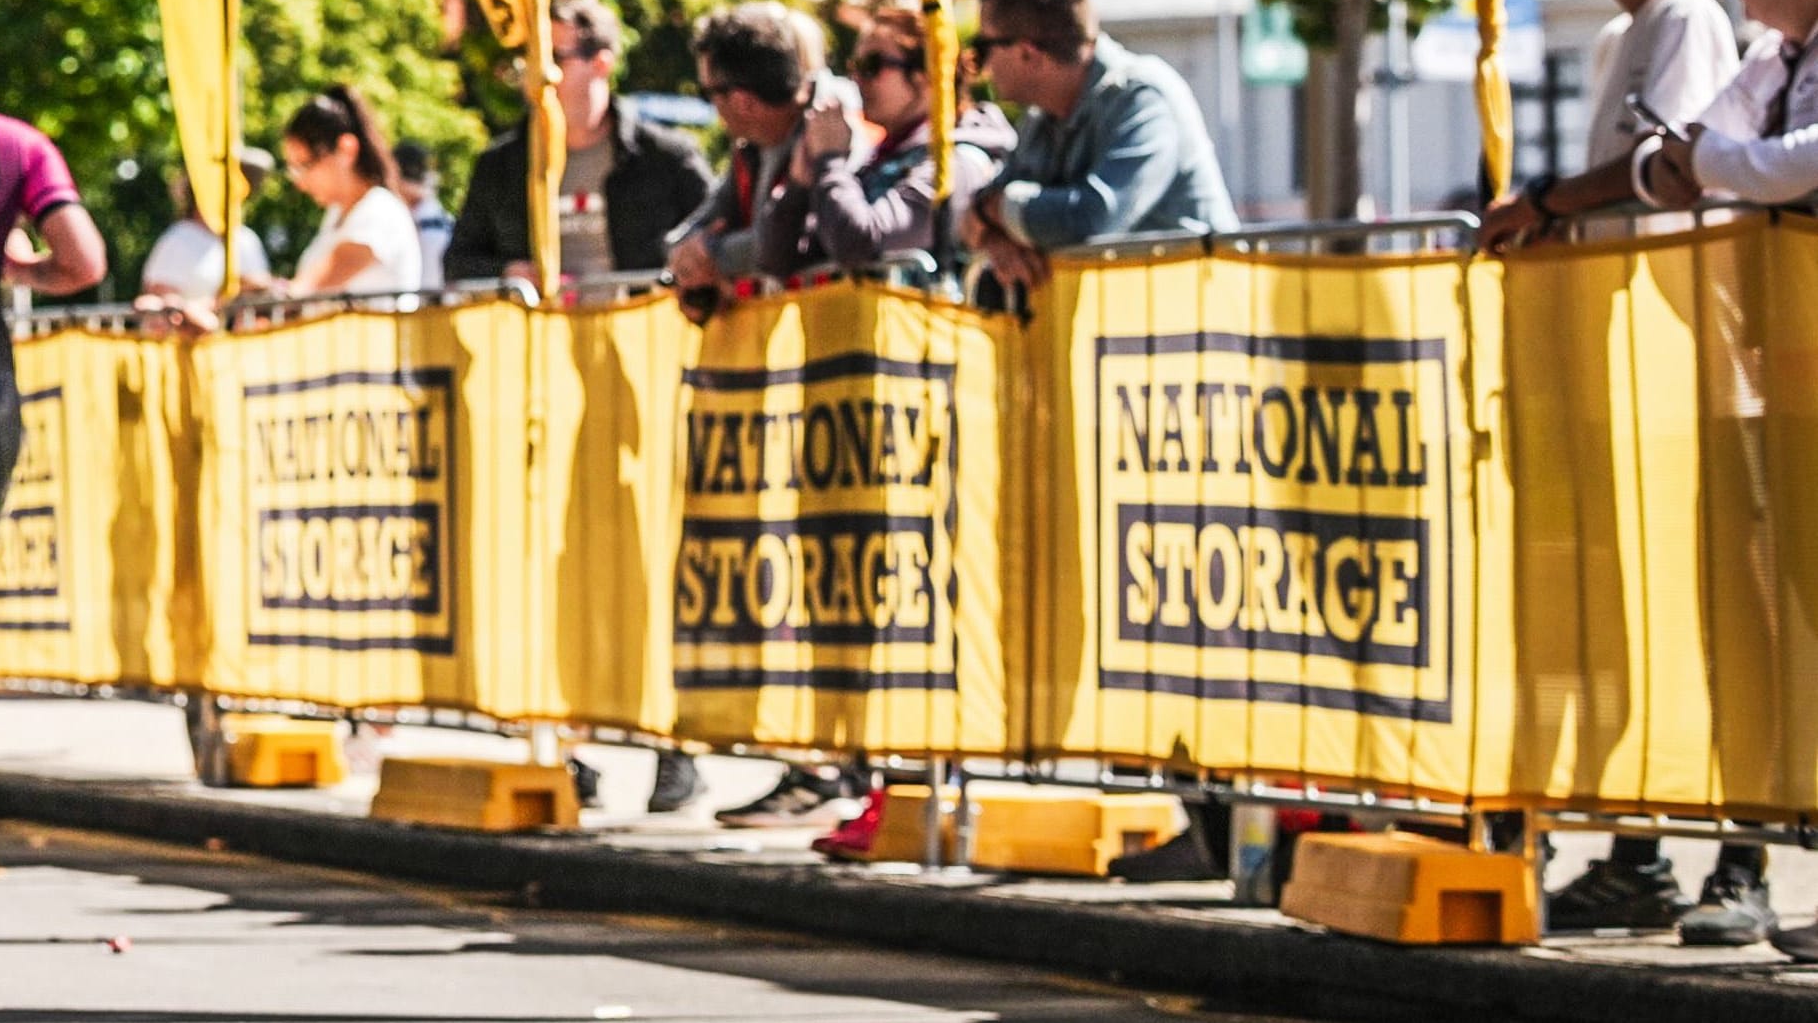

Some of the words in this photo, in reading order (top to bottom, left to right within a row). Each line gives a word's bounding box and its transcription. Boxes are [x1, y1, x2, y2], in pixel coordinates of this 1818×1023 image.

[256, 408, 442, 483] NATIONAL
[685, 398, 936, 495] NATIONAL
[1115, 382, 1428, 487] NATIONAL
[261, 513, 431, 604] STORAGE
[678, 530, 931, 630] STORAGE
[1125, 519, 1420, 647] STORAGE
